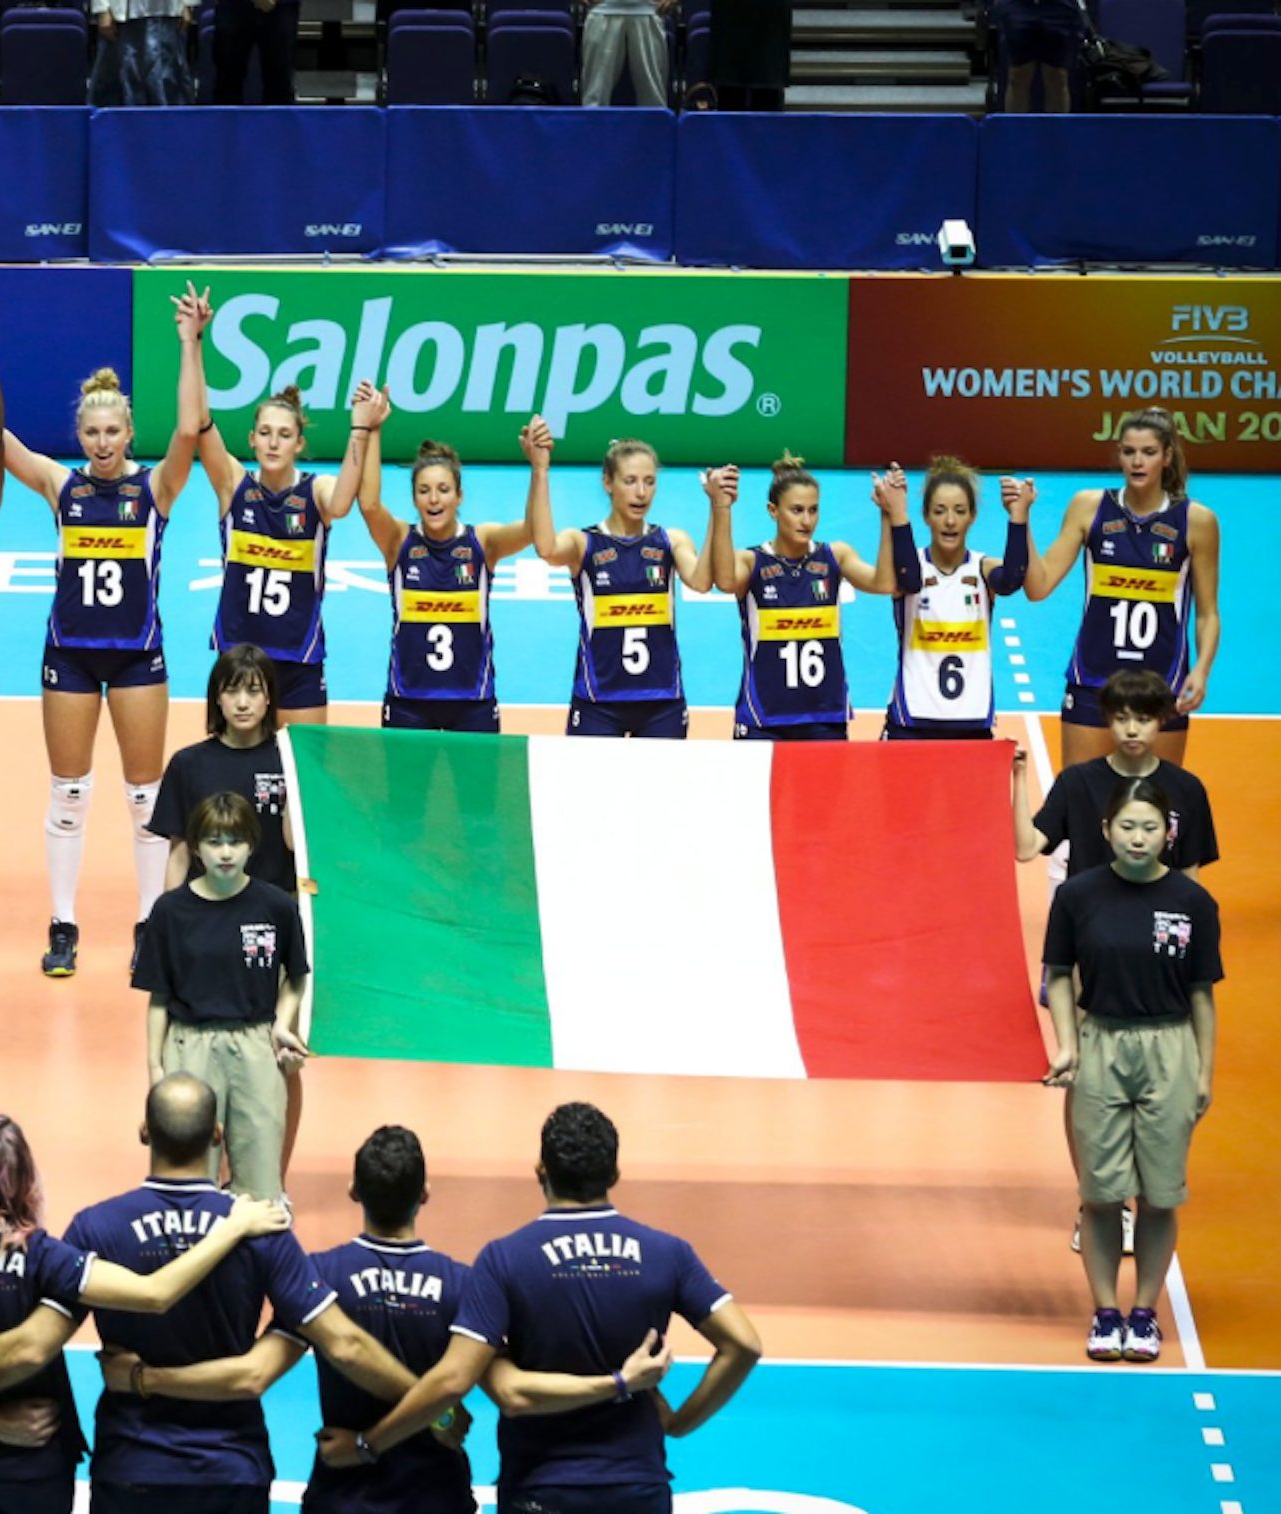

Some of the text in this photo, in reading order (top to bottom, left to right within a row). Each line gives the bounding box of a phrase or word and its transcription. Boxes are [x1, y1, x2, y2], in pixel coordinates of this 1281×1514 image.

[1171, 305, 1249, 331] FIVB
[1150, 351, 1268, 365] VOLLEYBALL
[921, 367, 1091, 398] WOMEN'S
[1099, 369, 1224, 399] WORLD
[78, 536, 126, 549] DHL
[246, 543, 297, 561] DHL
[77, 559, 124, 607] 13
[245, 567, 292, 616] 15
[1107, 575, 1160, 592] DHL
[415, 601, 466, 613] DHL
[608, 604, 656, 617] DHL
[776, 617, 824, 630] DHL
[923, 631, 973, 643] DHL
[1110, 599, 1158, 649] 10
[425, 624, 455, 672] 3
[621, 627, 650, 675] 5
[779, 639, 825, 688] 16
[937, 654, 965, 700] 6
[541, 1232, 642, 1267] ITALIA
[349, 1267, 443, 1304] ITALIA
